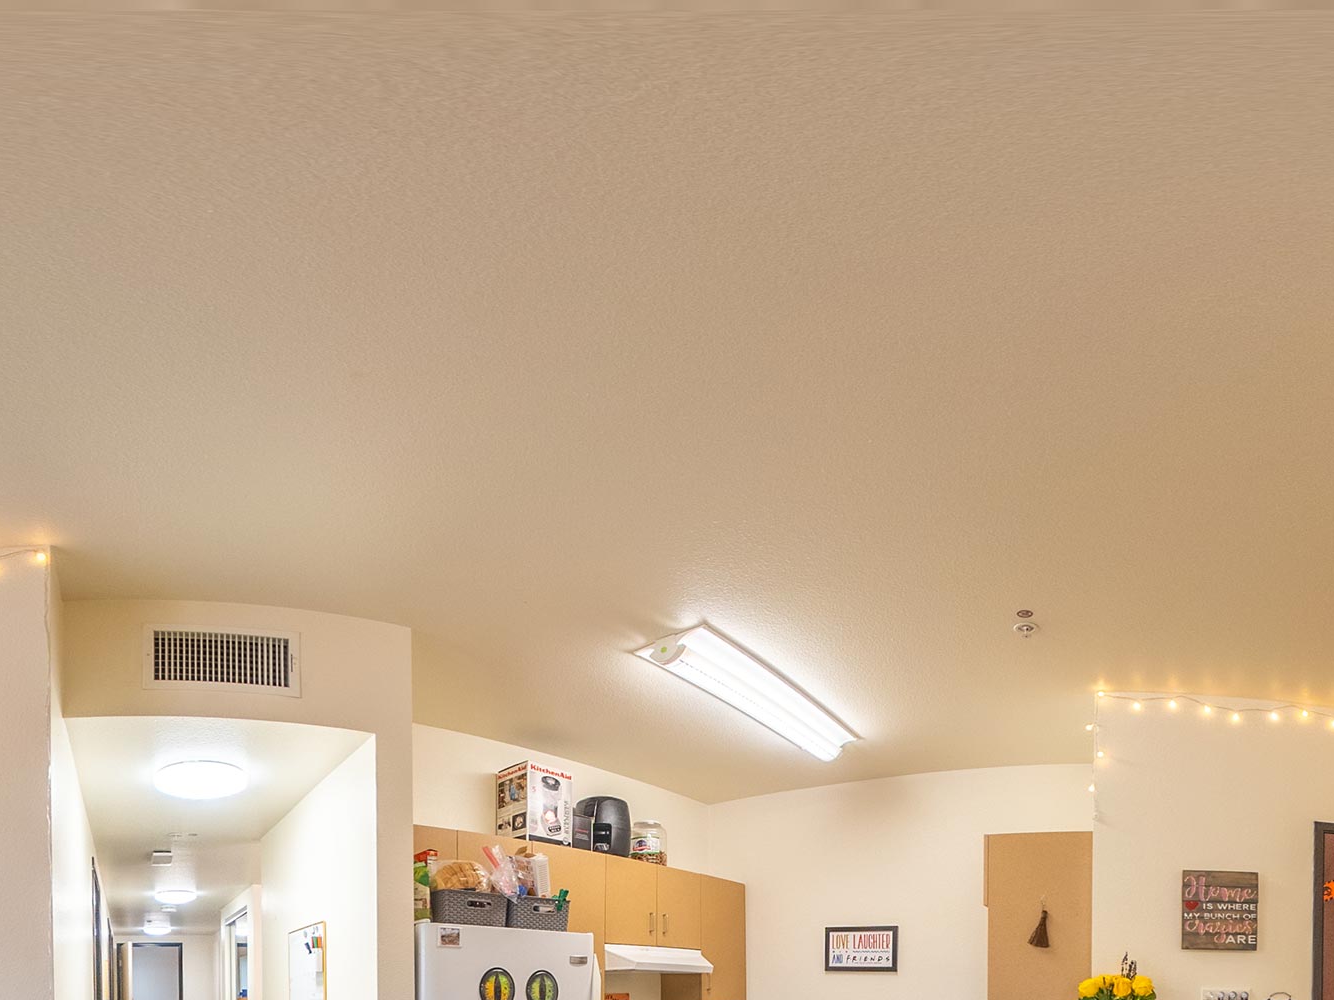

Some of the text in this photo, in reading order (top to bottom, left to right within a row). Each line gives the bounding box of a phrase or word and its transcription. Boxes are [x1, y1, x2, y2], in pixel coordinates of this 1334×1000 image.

[498, 764, 528, 780] KitchenAid
[530, 763, 573, 782] KitchenAid
[1184, 875, 1257, 902] Home
[1217, 903, 1256, 911] WHERE
[1183, 912, 1200, 920] MY
[1204, 912, 1240, 920] BUNCH
[831, 933, 891, 950] LOVE LAUGHTER
[1225, 934, 1257, 944] ARE
